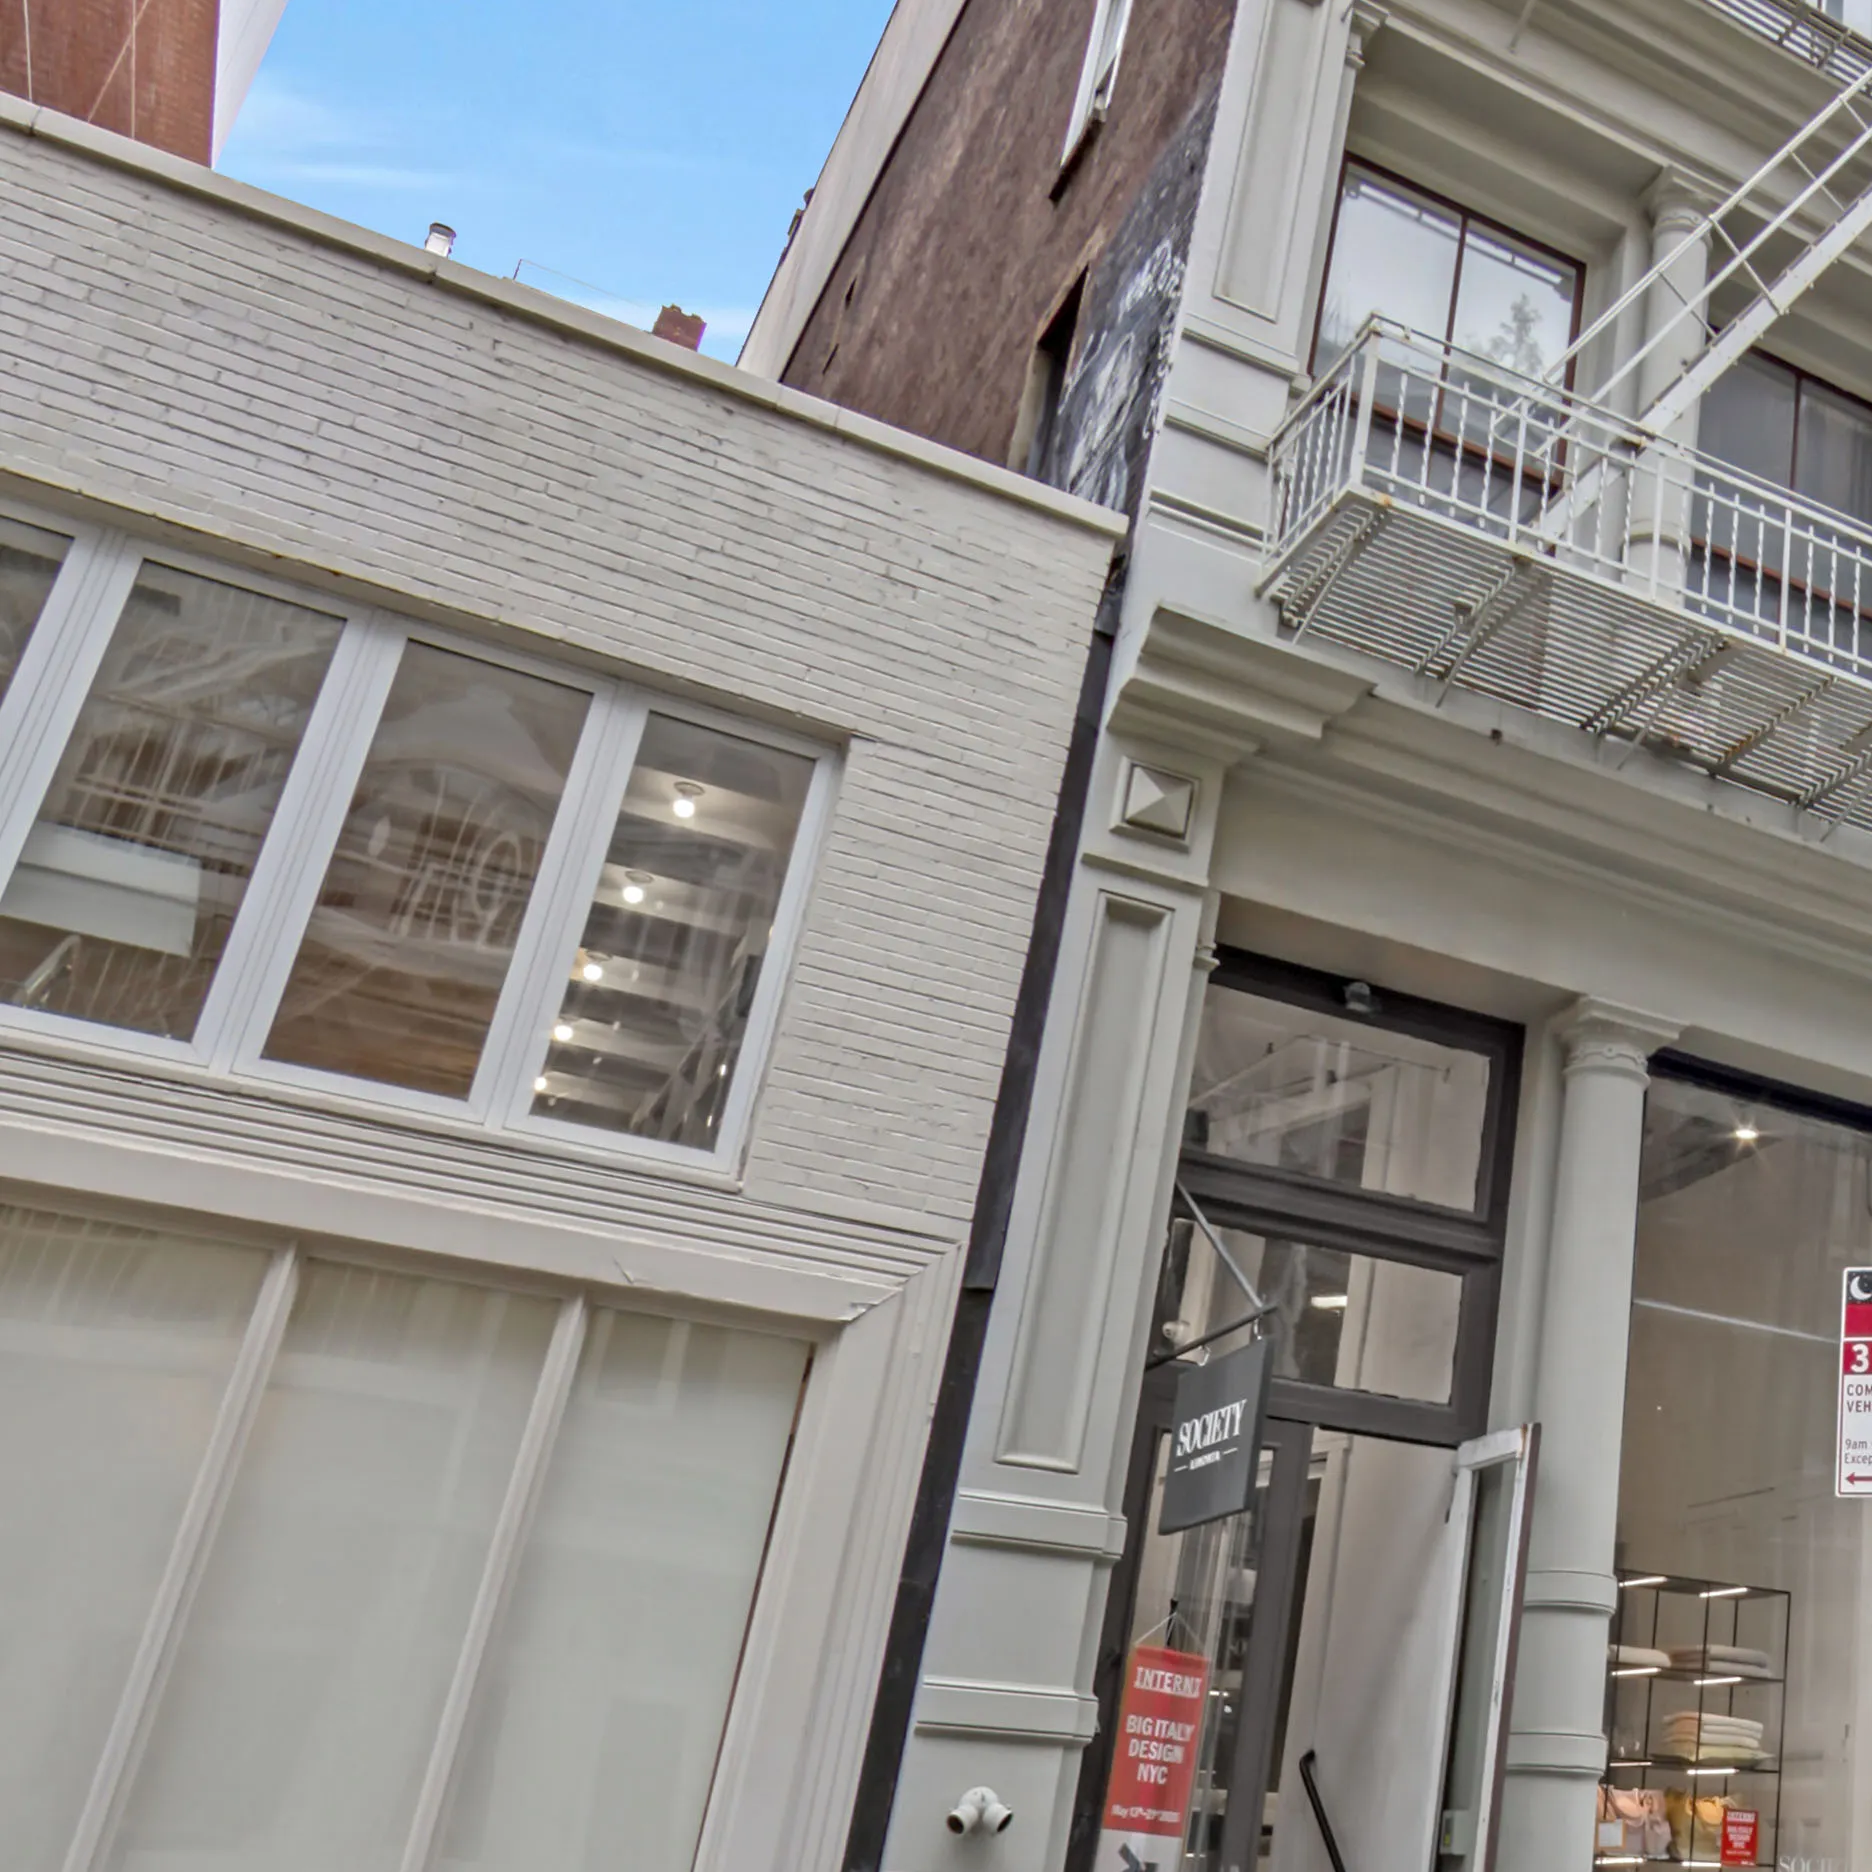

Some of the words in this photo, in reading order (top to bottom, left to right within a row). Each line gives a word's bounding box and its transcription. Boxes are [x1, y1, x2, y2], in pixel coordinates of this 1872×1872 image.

[1850, 1343, 1870, 1374] 3
[1176, 1398, 1248, 1457] SOCIETY
[1845, 1438, 1868, 1449] 9am
[1125, 1714, 1153, 1737] BIG
[1154, 1719, 1195, 1743] ITALY
[1128, 1738, 1186, 1765] DESIGN
[1136, 1763, 1168, 1786] NYC
